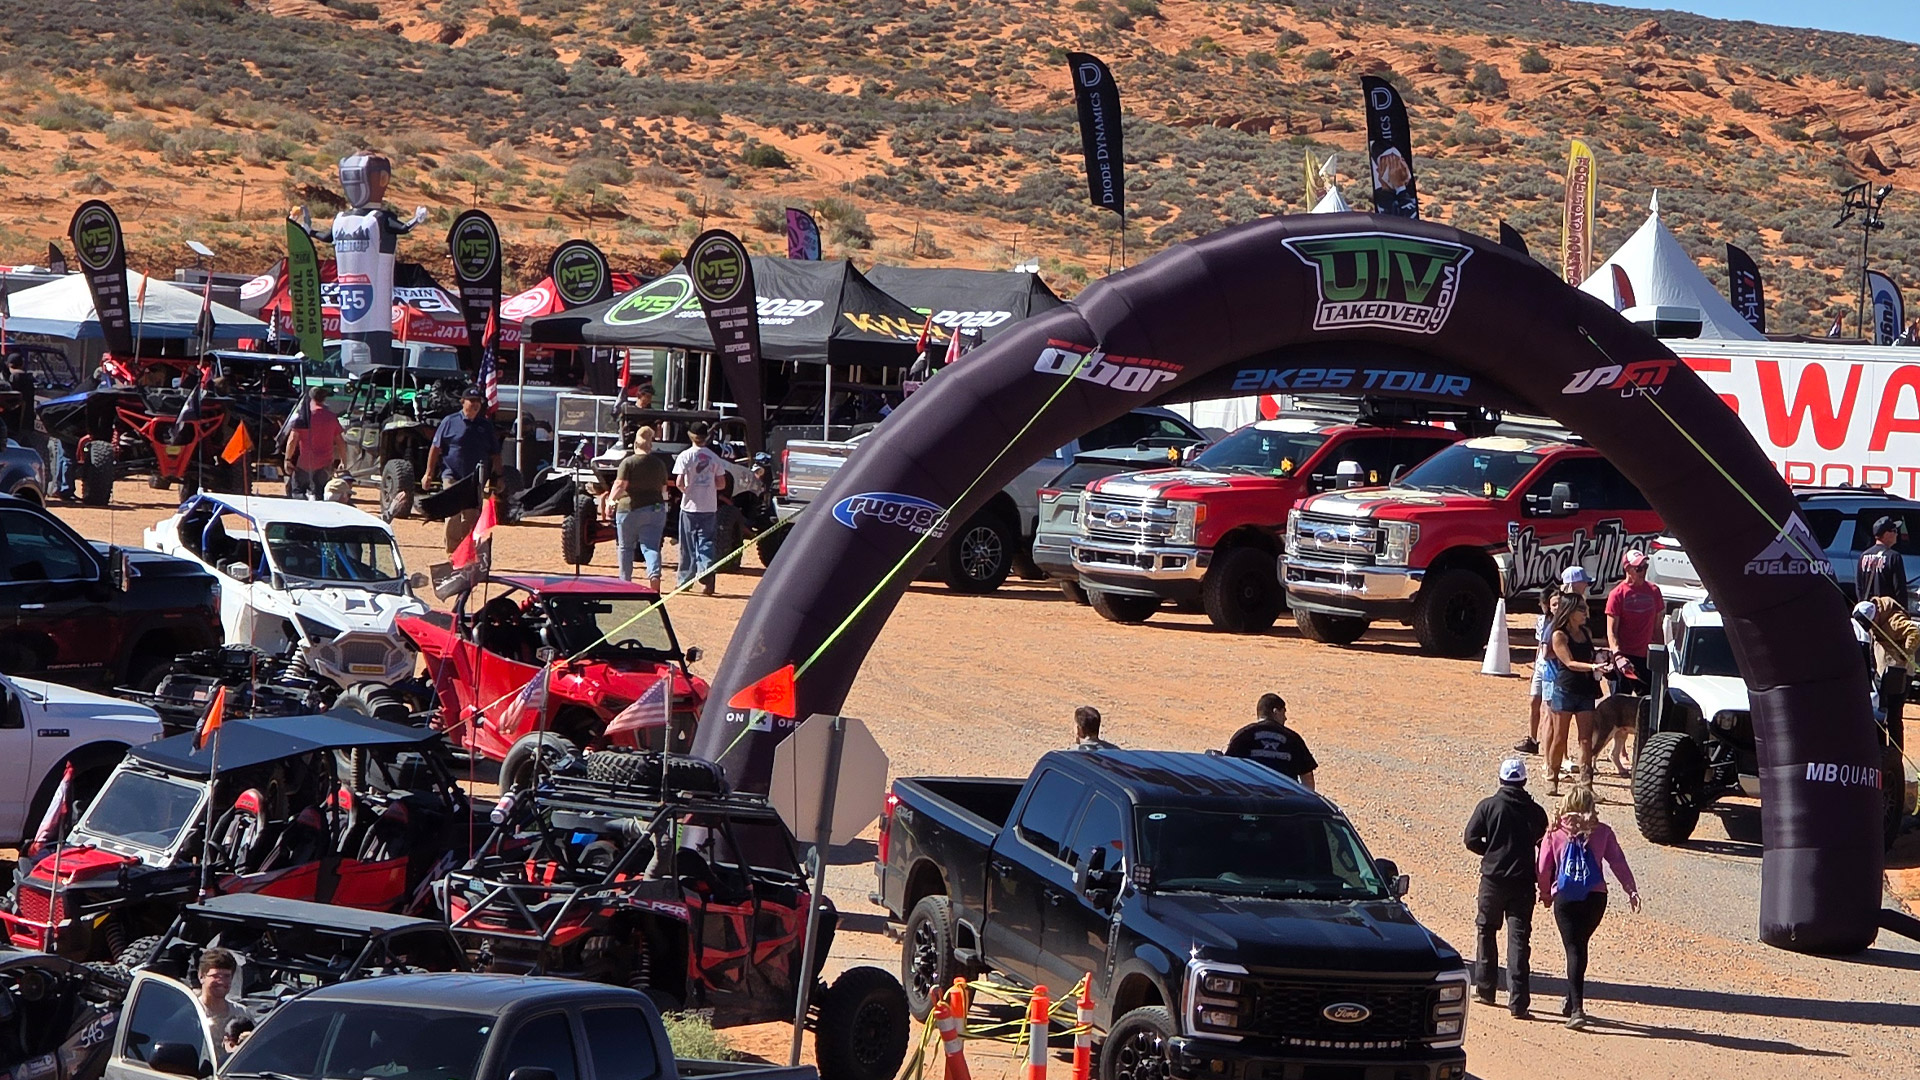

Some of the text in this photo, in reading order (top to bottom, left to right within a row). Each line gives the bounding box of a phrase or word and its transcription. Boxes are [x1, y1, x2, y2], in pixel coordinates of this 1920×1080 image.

[1089, 92, 1114, 204] DIODE DYNAMICS
[82, 226, 111, 248] MTS
[459, 239, 488, 258] MTS
[561, 263, 597, 284] MTS
[701, 258, 738, 279] MTS
[1299, 237, 1464, 304] UTV
[293, 270, 303, 333] OFFICIAL
[307, 268, 317, 335] SPONSOR
[341, 290, 366, 310] I-5
[621, 295, 680, 313] MTS
[1324, 304, 1435, 327] TAKEOVER
[1231, 369, 1471, 397] 2K25 TOUR
[1621, 386, 1662, 398] UTV
[908, 524, 944, 539] raos
[1503, 526, 1590, 598] Shock
[726, 713, 744, 722] ON
[652, 901, 687, 916] RZR
[1334, 1006, 1359, 1019] Ford
[81, 1018, 104, 1048] 545
